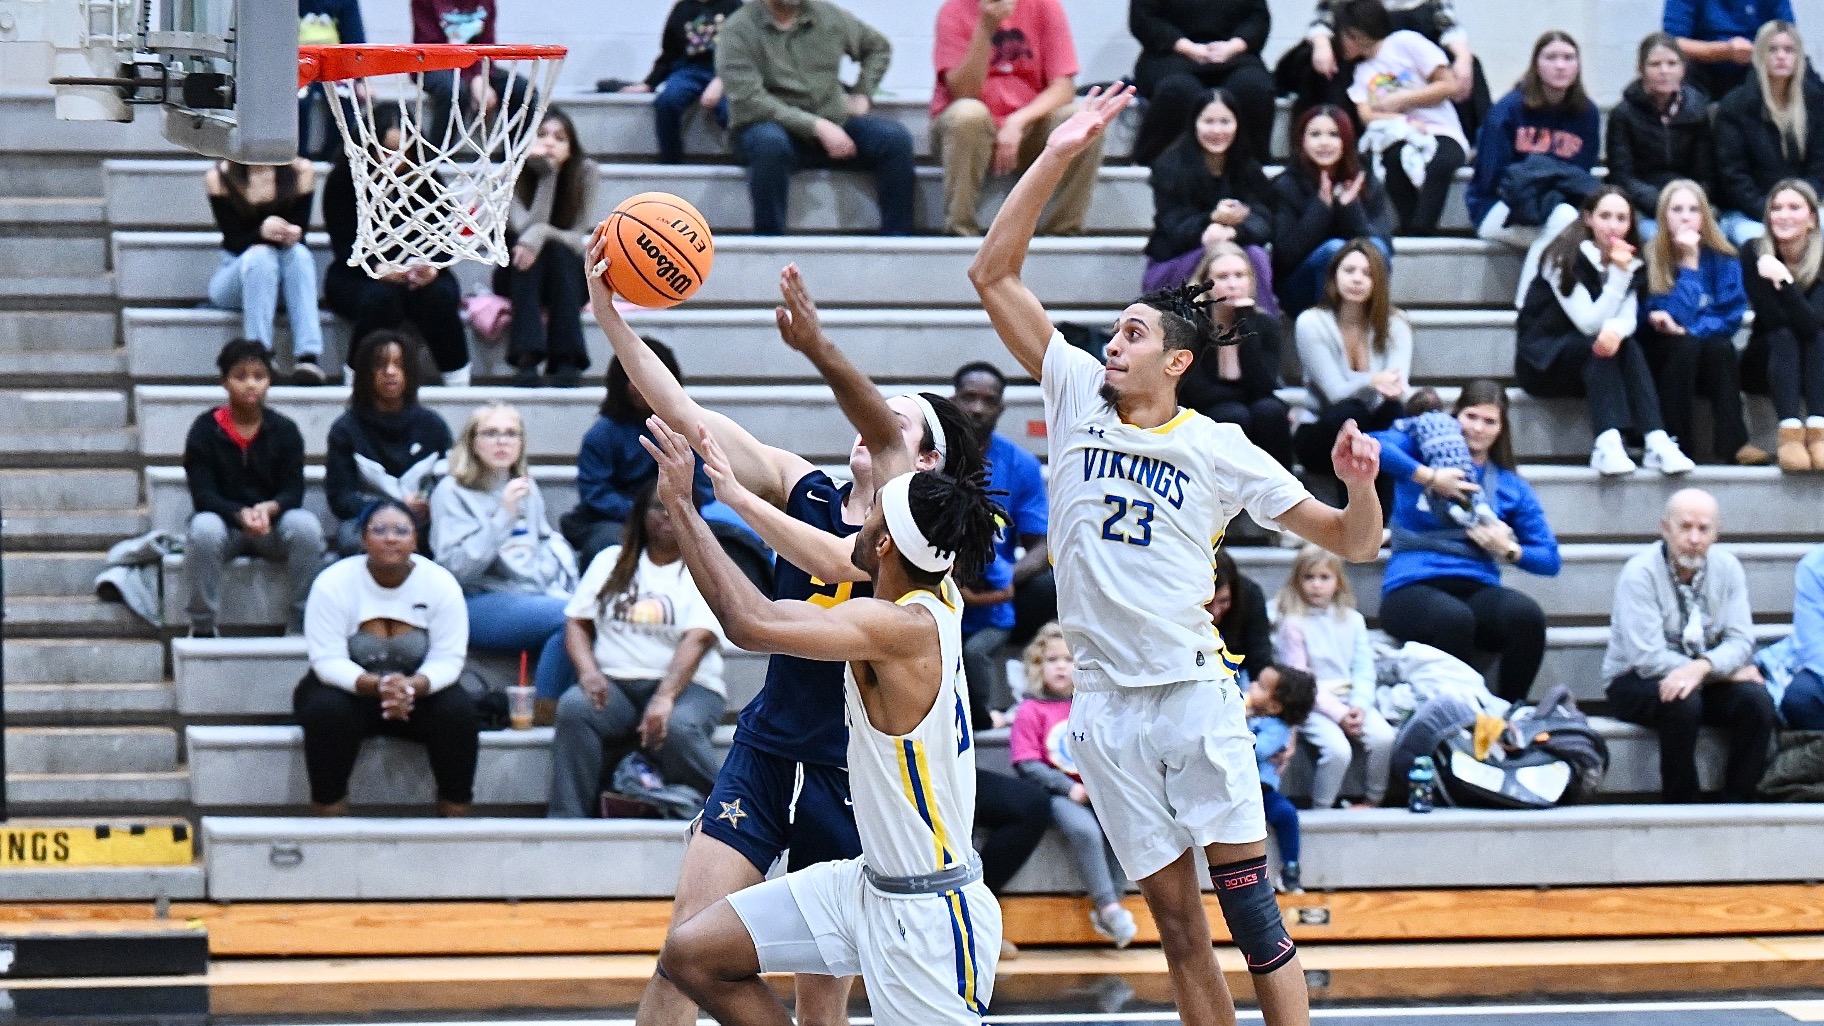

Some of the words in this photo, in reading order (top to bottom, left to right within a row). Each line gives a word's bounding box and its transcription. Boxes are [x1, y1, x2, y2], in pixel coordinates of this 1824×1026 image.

[636, 231, 693, 295] Wilson
[1083, 447, 1191, 510] VIKINGS
[1101, 493, 1155, 547] 23
[0, 832, 70, 861] NGS
